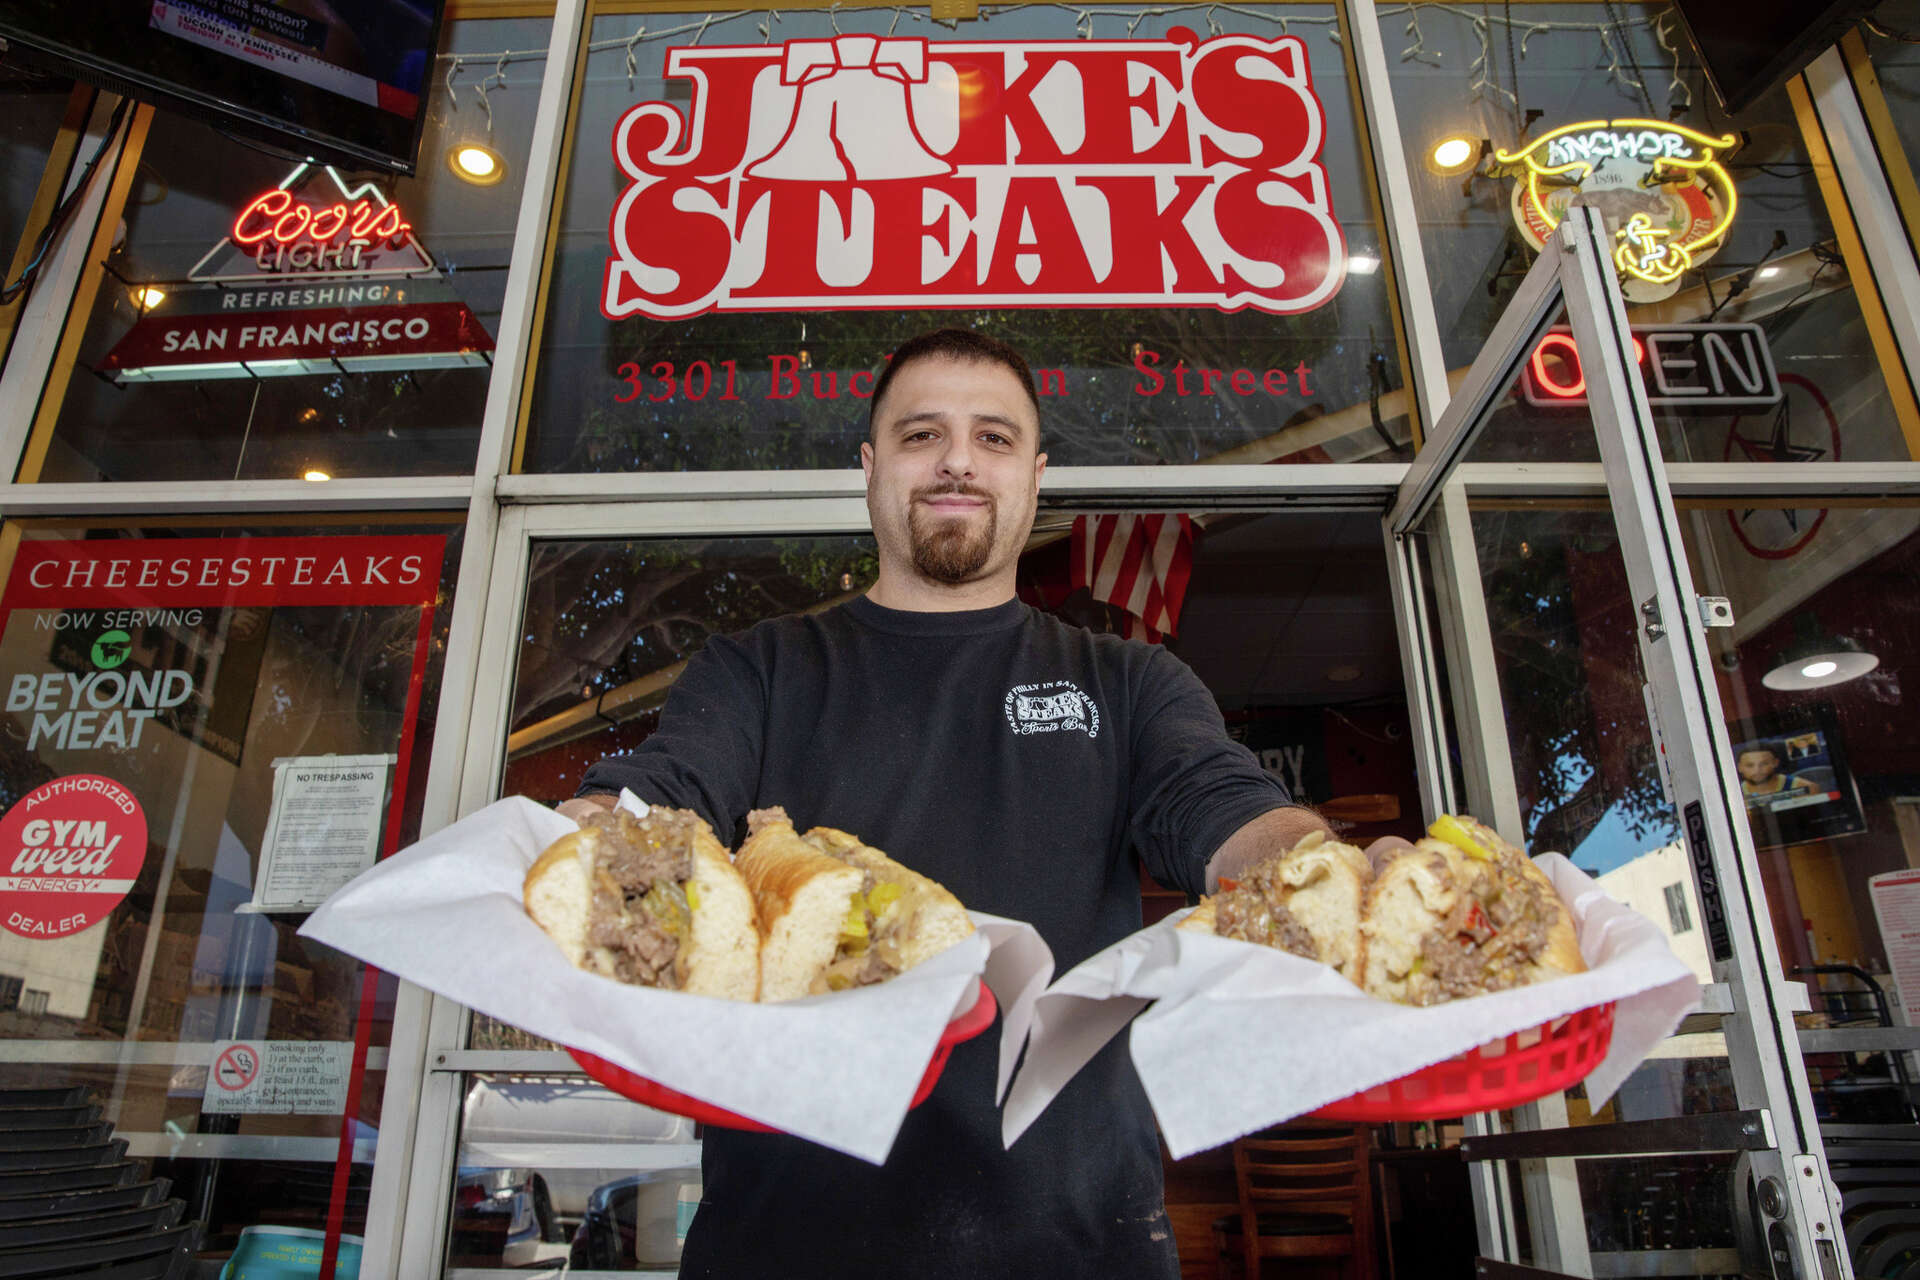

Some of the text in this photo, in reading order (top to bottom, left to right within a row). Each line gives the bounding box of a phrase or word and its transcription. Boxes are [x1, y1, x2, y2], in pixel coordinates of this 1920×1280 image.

[252, 3, 309, 30] season?
[183, 16, 224, 36] UCONN
[240, 37, 300, 63] TENNESSEE
[1547, 130, 1693, 167] ANCHOR
[232, 188, 411, 244] Coors
[254, 238, 371, 271] LIGHT
[604, 166, 1344, 318] STEAKS
[222, 284, 384, 309] REFRESHING
[163, 317, 431, 352] SAN FRANCISCO
[613, 350, 1316, 404] 3301 Bucn Street
[29, 555, 422, 590] CHEESESTEAKS
[34, 609, 203, 632] NOW SERVING
[5, 669, 193, 713] BEYOND
[1005, 691, 1015, 704] OF
[1011, 683, 1040, 696] PHILLY
[1055, 680, 1079, 692] SAN
[1005, 703, 1021, 735] TASTE
[1017, 704, 1085, 721] STEAKS
[1020, 717, 1089, 736] Sports Bar
[1076, 690, 1100, 738] FRANCISCO
[26, 709, 156, 752] MEAT
[296, 771, 375, 783] NO TRESPASSING
[25, 778, 136, 816] AUTHORIZED
[21, 819, 108, 848] GYM
[10, 834, 123, 876] weed
[1688, 815, 1724, 923] PUSH
[17, 879, 92, 892] ENERGY
[7, 911, 87, 935] DEALER
[269, 1043, 326, 1054] Smoking only
[278, 1055, 287, 1064] at
[291, 1054, 303, 1063] the
[264, 1076, 272, 1084] at
[273, 1075, 294, 1084] least
[296, 1075, 306, 1084] 15
[318, 1075, 340, 1085] from
[276, 1064, 285, 1073] if
[295, 1096, 312, 1106] and
